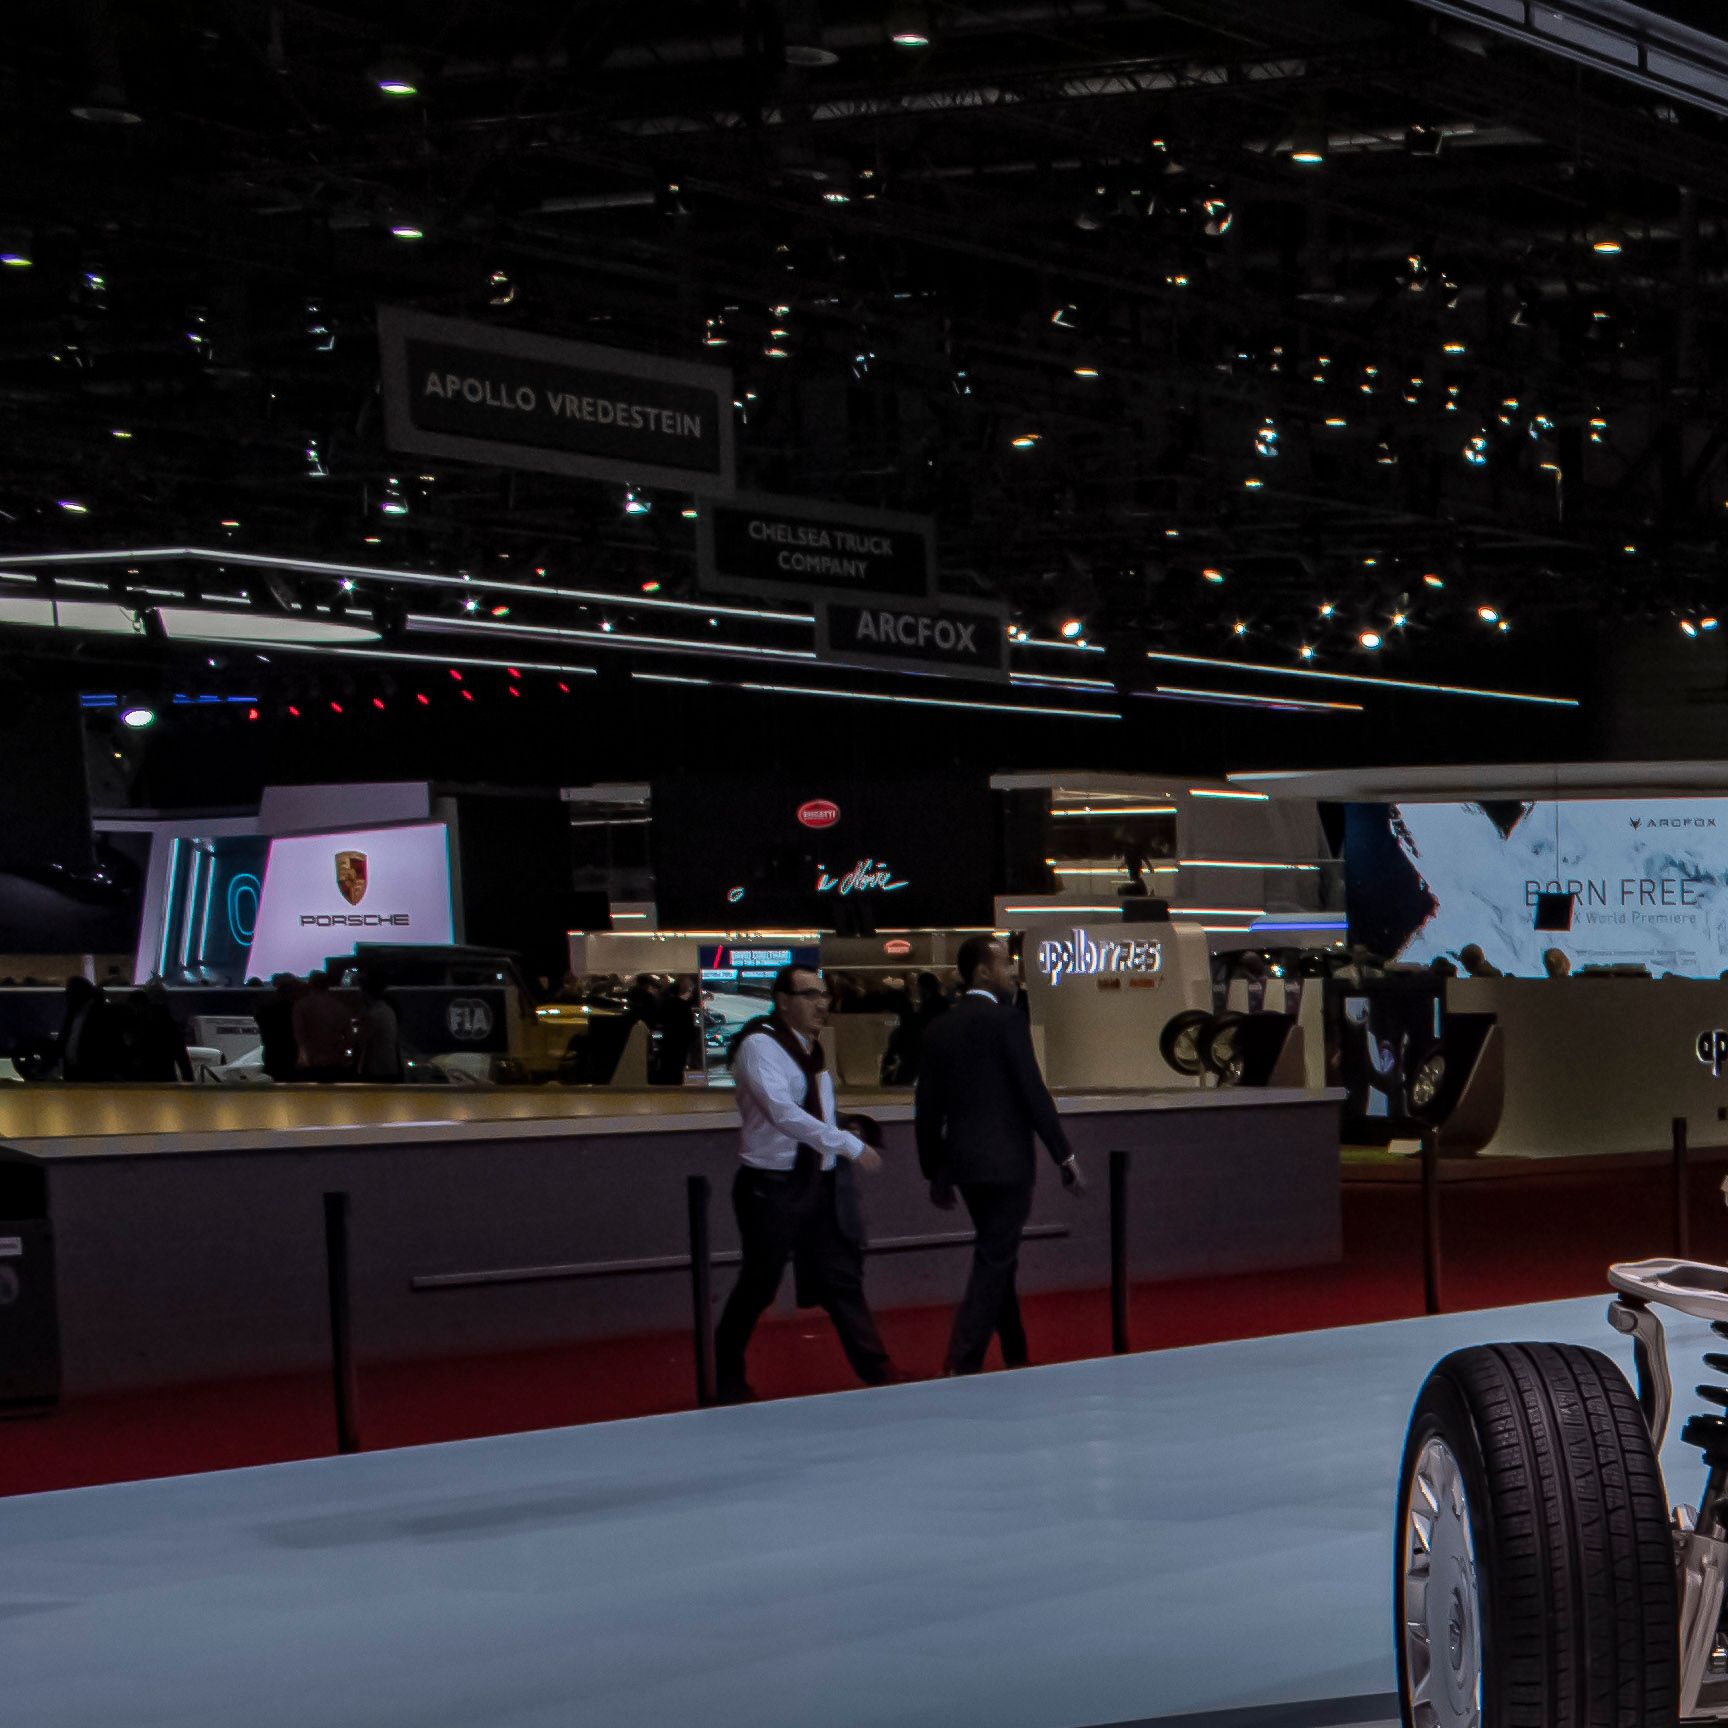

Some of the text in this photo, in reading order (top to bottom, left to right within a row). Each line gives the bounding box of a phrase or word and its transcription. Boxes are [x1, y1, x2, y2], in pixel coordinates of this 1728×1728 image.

[424, 371, 701, 439] APOLLO VREDESTEIN
[748, 519, 895, 556] CHELSEA TRUCK
[777, 551, 872, 579] COMPANY
[856, 610, 977, 654] ARCFOX
[1646, 818, 1717, 828] ARCFOX
[1621, 878, 1698, 906] FREE
[300, 914, 410, 927] PORSCHE
[1631, 911, 1697, 924] Premiere
[449, 1007, 490, 1032] FIA
